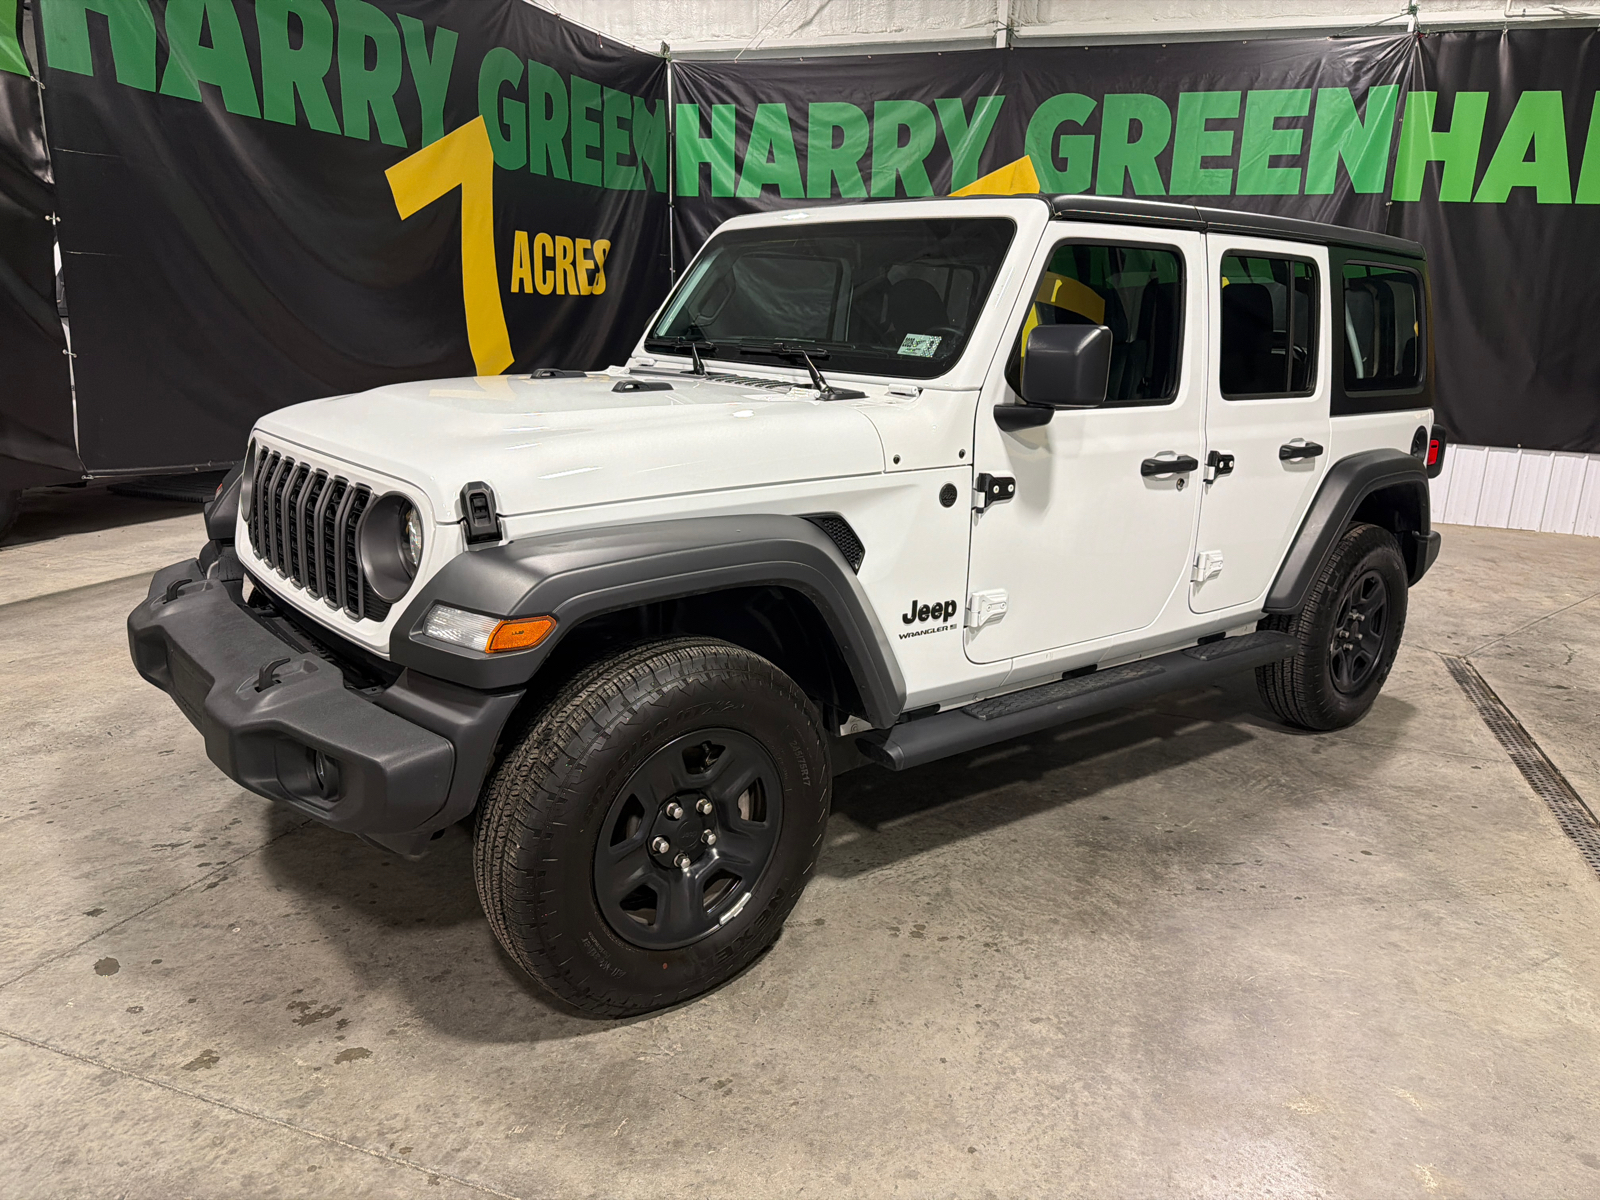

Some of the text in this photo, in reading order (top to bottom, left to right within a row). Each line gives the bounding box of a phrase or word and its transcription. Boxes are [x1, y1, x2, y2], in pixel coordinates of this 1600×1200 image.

[478, 46, 667, 193] GREEN
[676, 95, 1006, 198] HARRY
[1025, 85, 1399, 196] GREEN
[1391, 90, 1600, 204] HA
[384, 115, 611, 376] 7 ACRES
[899, 626, 948, 640] WRANGLER
[902, 599, 957, 624] Jeep
